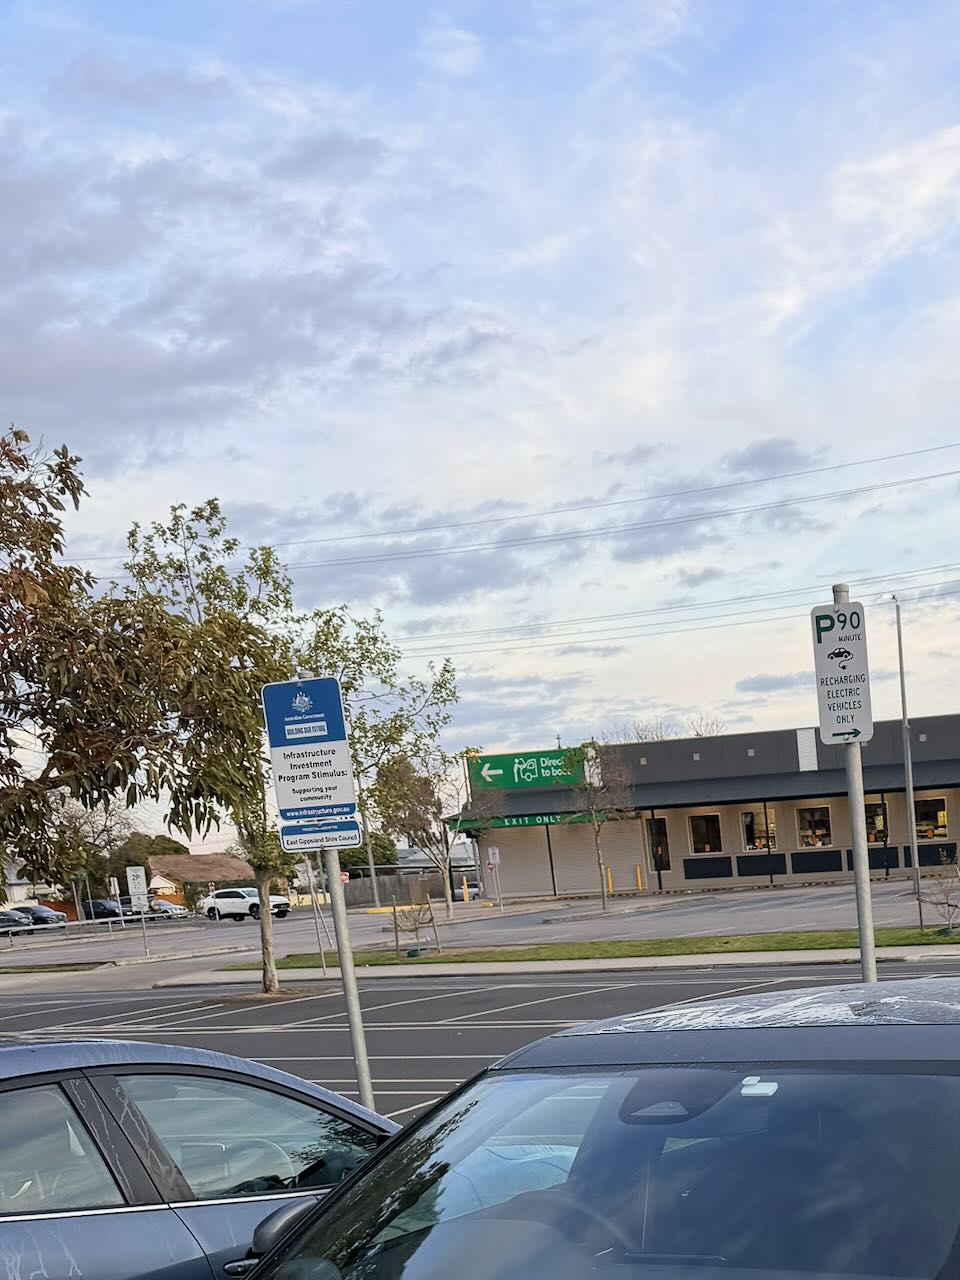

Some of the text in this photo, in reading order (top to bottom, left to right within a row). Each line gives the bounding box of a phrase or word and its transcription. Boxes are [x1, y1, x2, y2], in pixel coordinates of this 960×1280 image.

[838, 634, 862, 642] MINUTE
[820, 673, 866, 687] RECHARGING
[826, 687, 861, 699] ELECTRIC
[827, 700, 862, 712] VEHICLES
[836, 714, 855, 724] ONLY
[283, 748, 336, 760] Infrastructure
[289, 759, 332, 770] Investment
[540, 757, 565, 767] Direc
[278, 769, 348, 783] Program Stimulus:
[541, 767, 551, 777] to
[292, 785, 338, 795] Supporting your
[300, 794, 332, 802] community
[504, 815, 561, 826] EXIT ONLY
